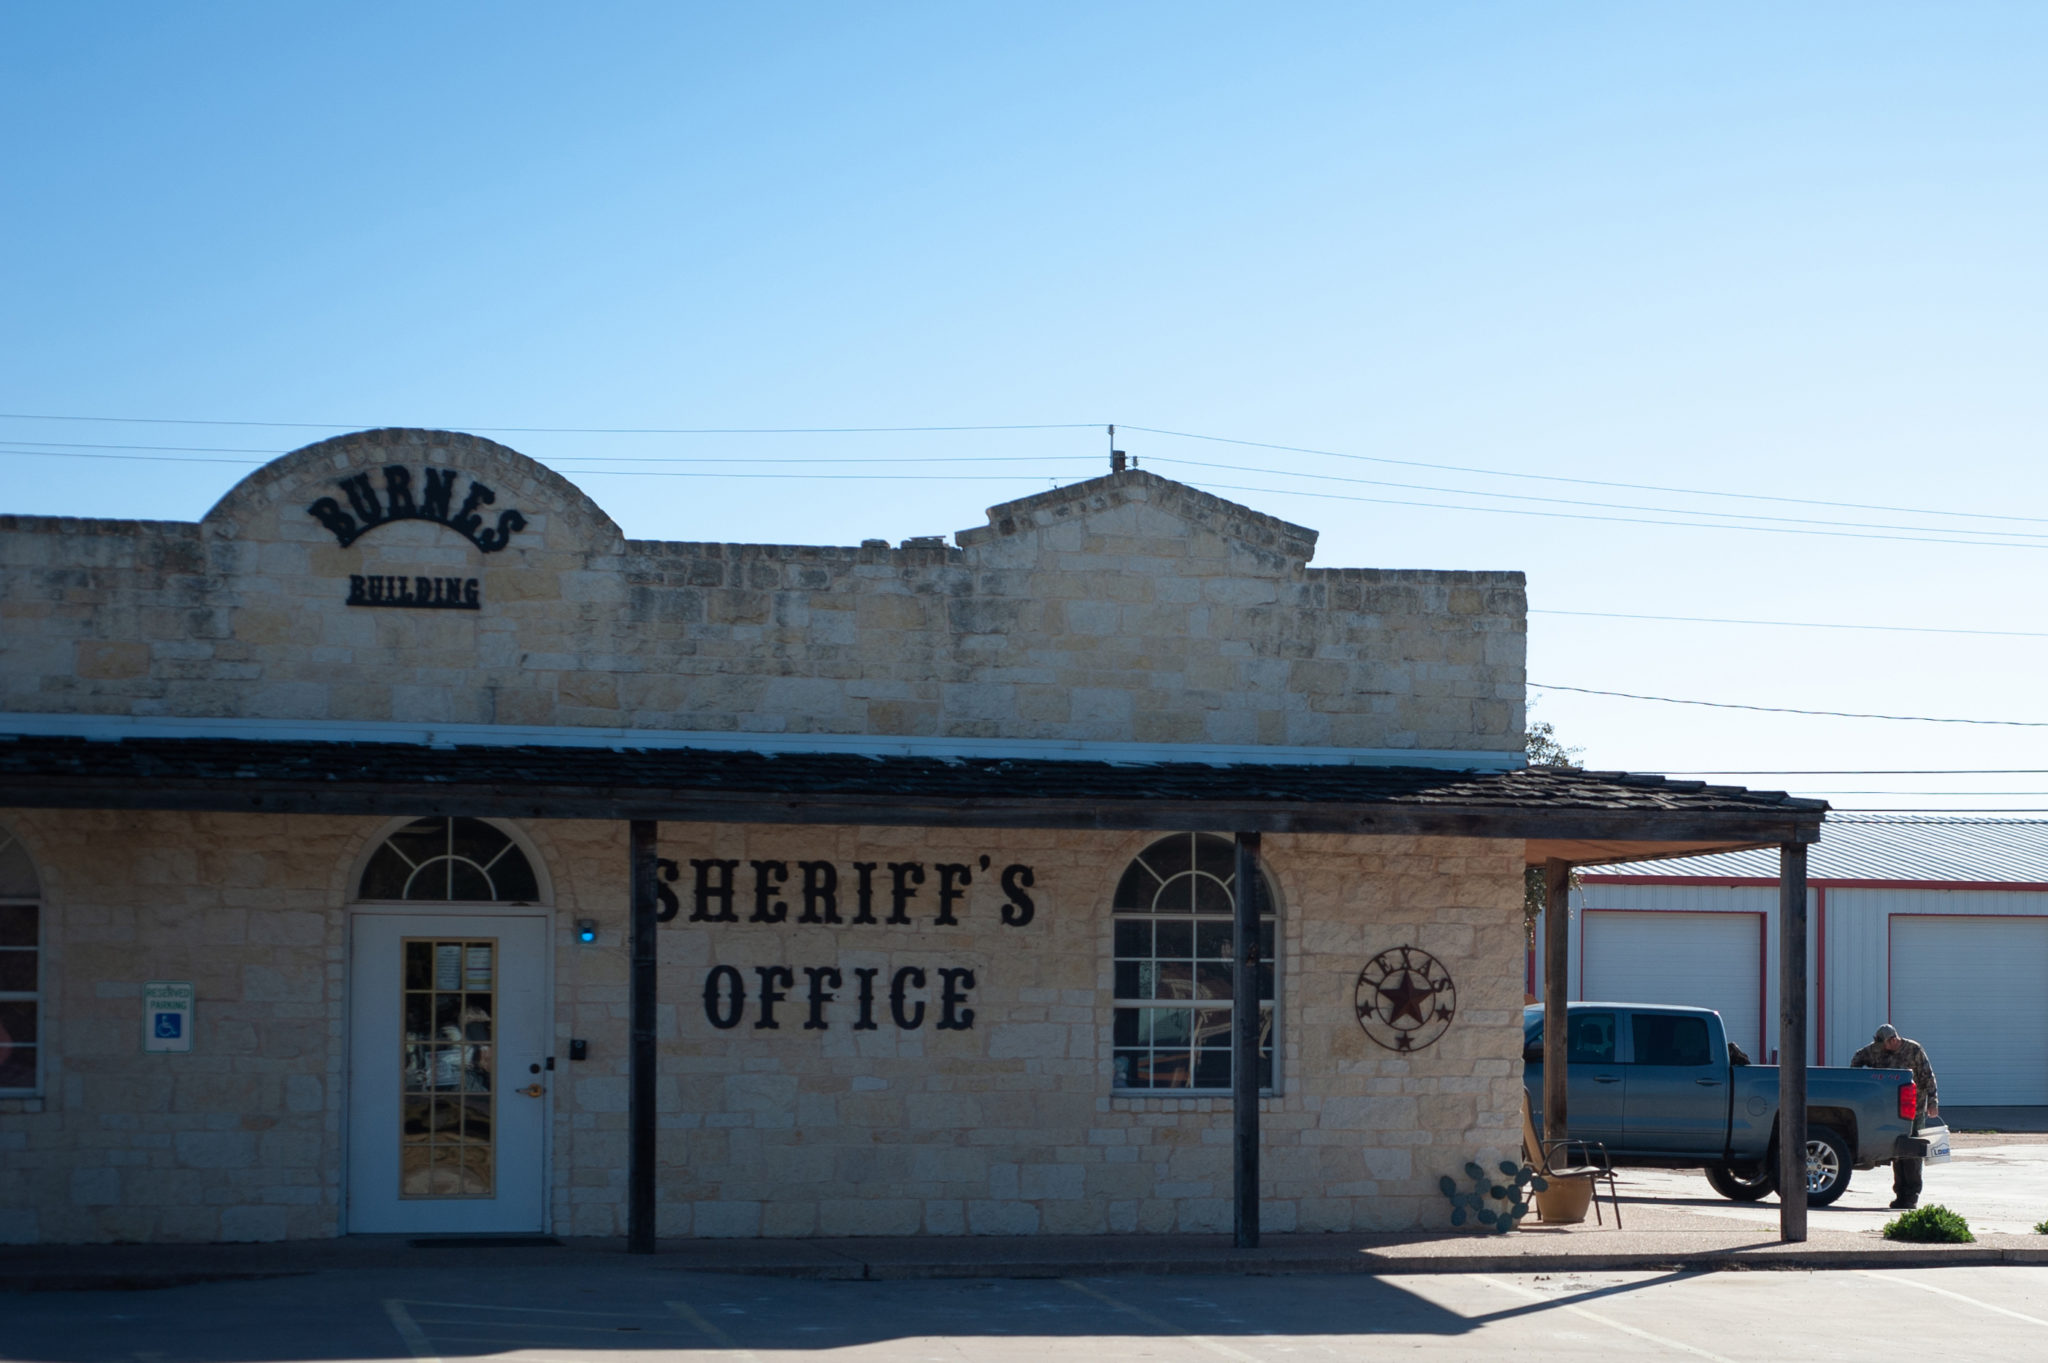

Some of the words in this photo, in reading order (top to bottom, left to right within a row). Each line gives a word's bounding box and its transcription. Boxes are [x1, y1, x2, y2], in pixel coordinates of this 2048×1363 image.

[308, 465, 528, 553] BURNES
[349, 574, 480, 604] BUILDING
[656, 855, 1035, 927] SHERIFF'S
[1358, 947, 1453, 992] TEXAS
[150, 1000, 188, 1009] PARKING
[703, 965, 976, 1030] OFFICE
